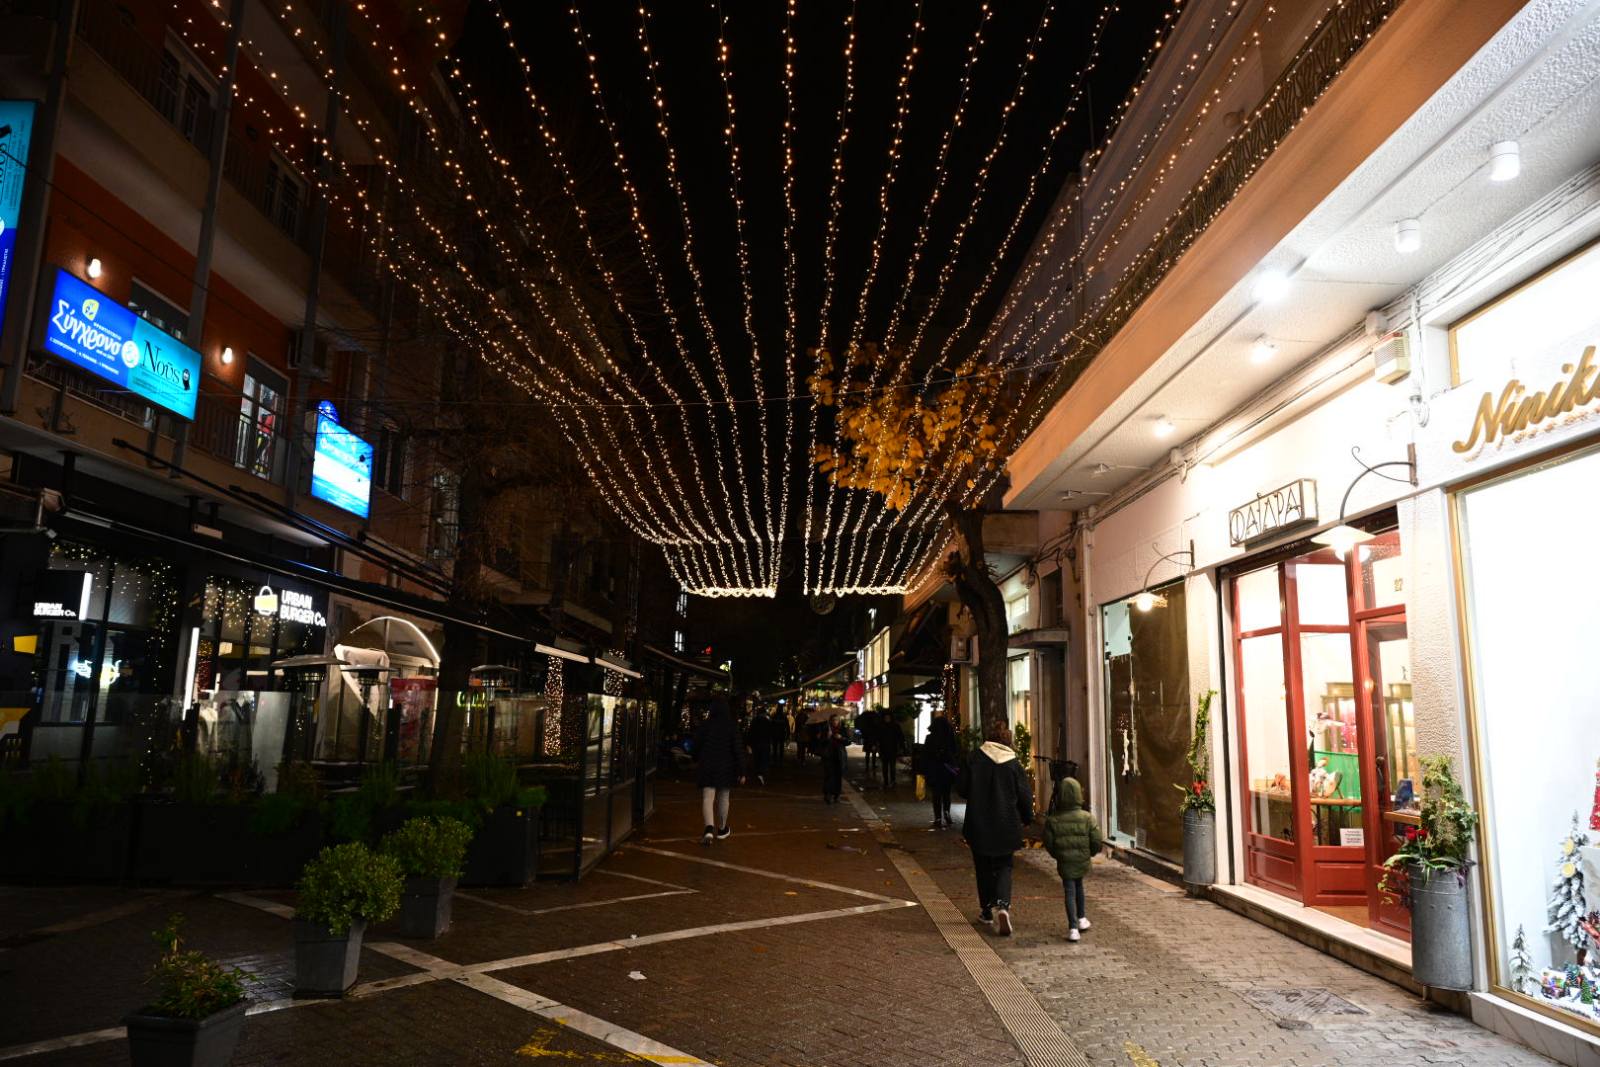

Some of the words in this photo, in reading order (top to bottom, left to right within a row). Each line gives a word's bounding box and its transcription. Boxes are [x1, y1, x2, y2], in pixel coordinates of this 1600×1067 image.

[52, 299, 122, 356] Σύγχρονο
[1452, 345, 1600, 453] Ninik
[34, 602, 63, 610] URBAN
[281, 589, 313, 610] URBAN
[280, 604, 314, 625] BURGER
[314, 611, 327, 627] Co.
